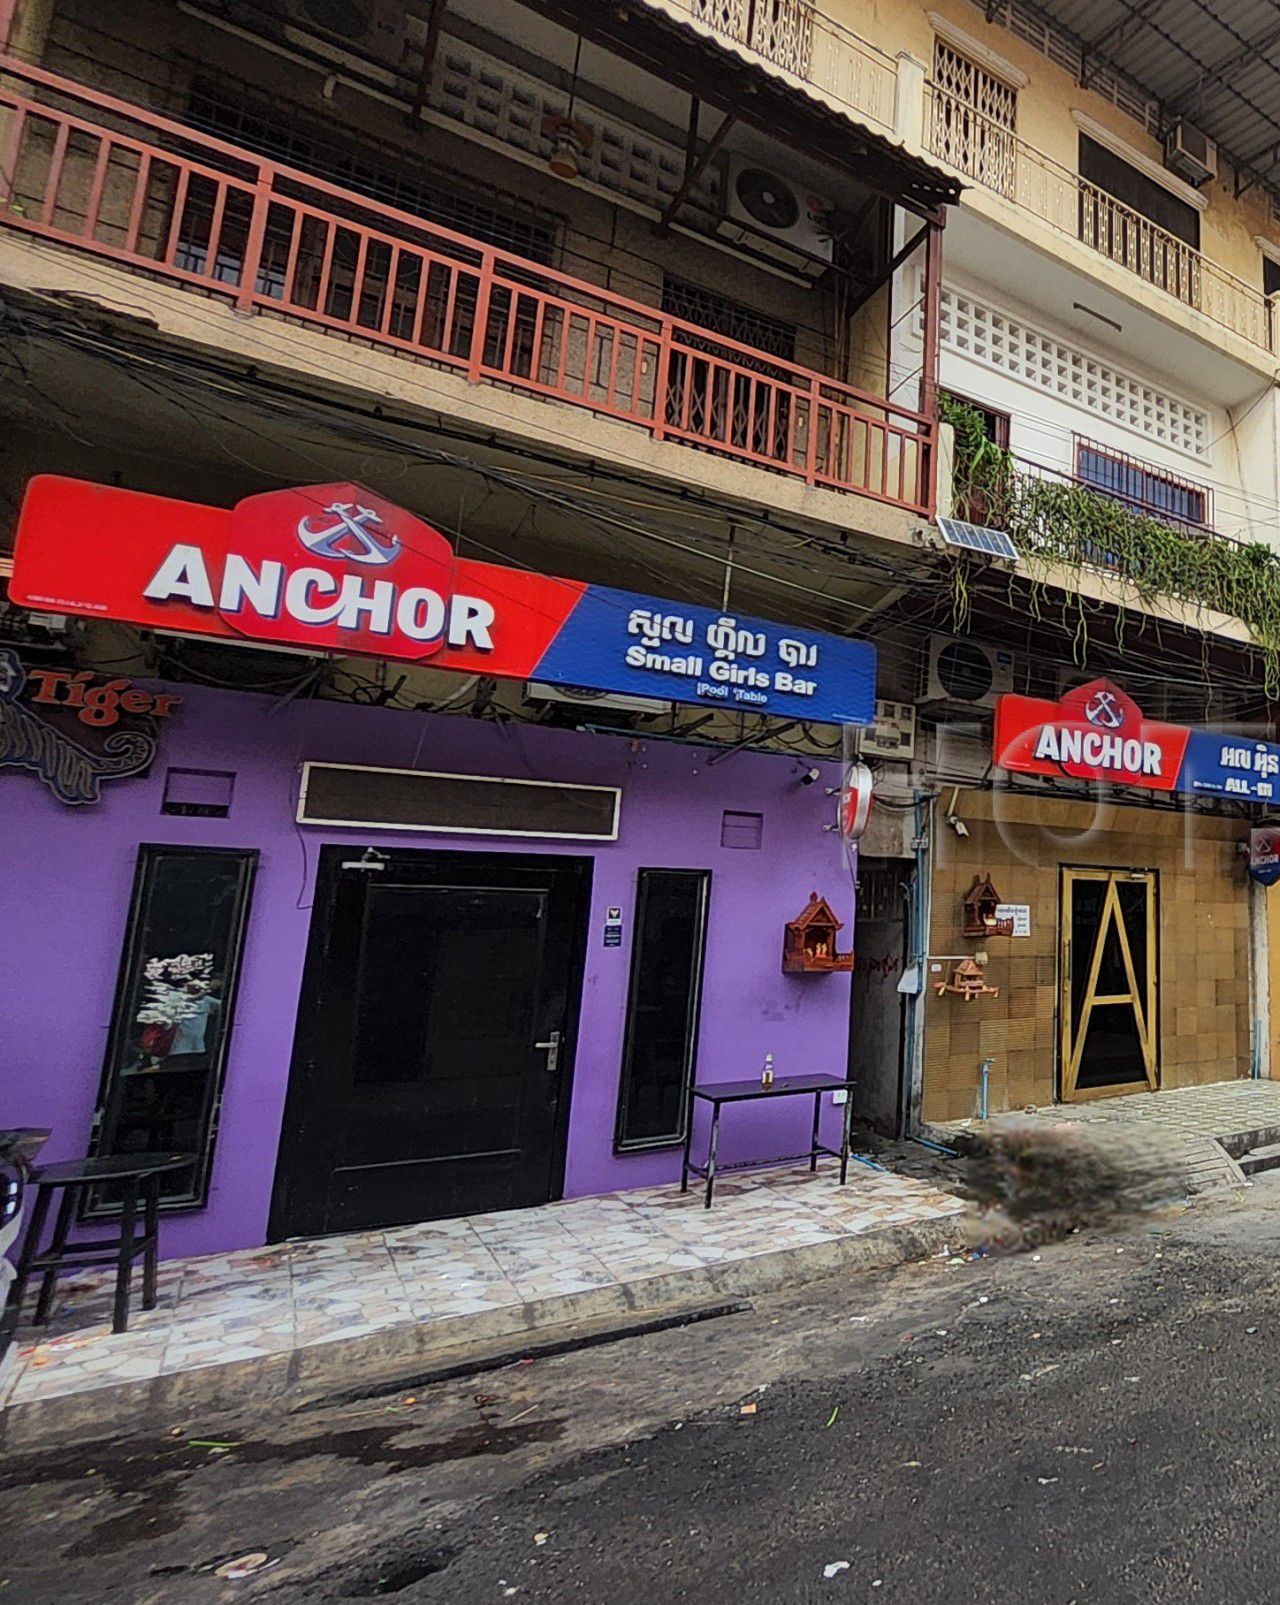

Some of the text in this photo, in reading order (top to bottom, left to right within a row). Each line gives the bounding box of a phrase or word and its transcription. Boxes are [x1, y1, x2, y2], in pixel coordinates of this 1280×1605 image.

[142, 543, 496, 652] ANCHOR
[27, 669, 184, 727] Tiger
[625, 645, 818, 696] Small Girls Bar
[1034, 724, 1162, 777] ANCHOR
